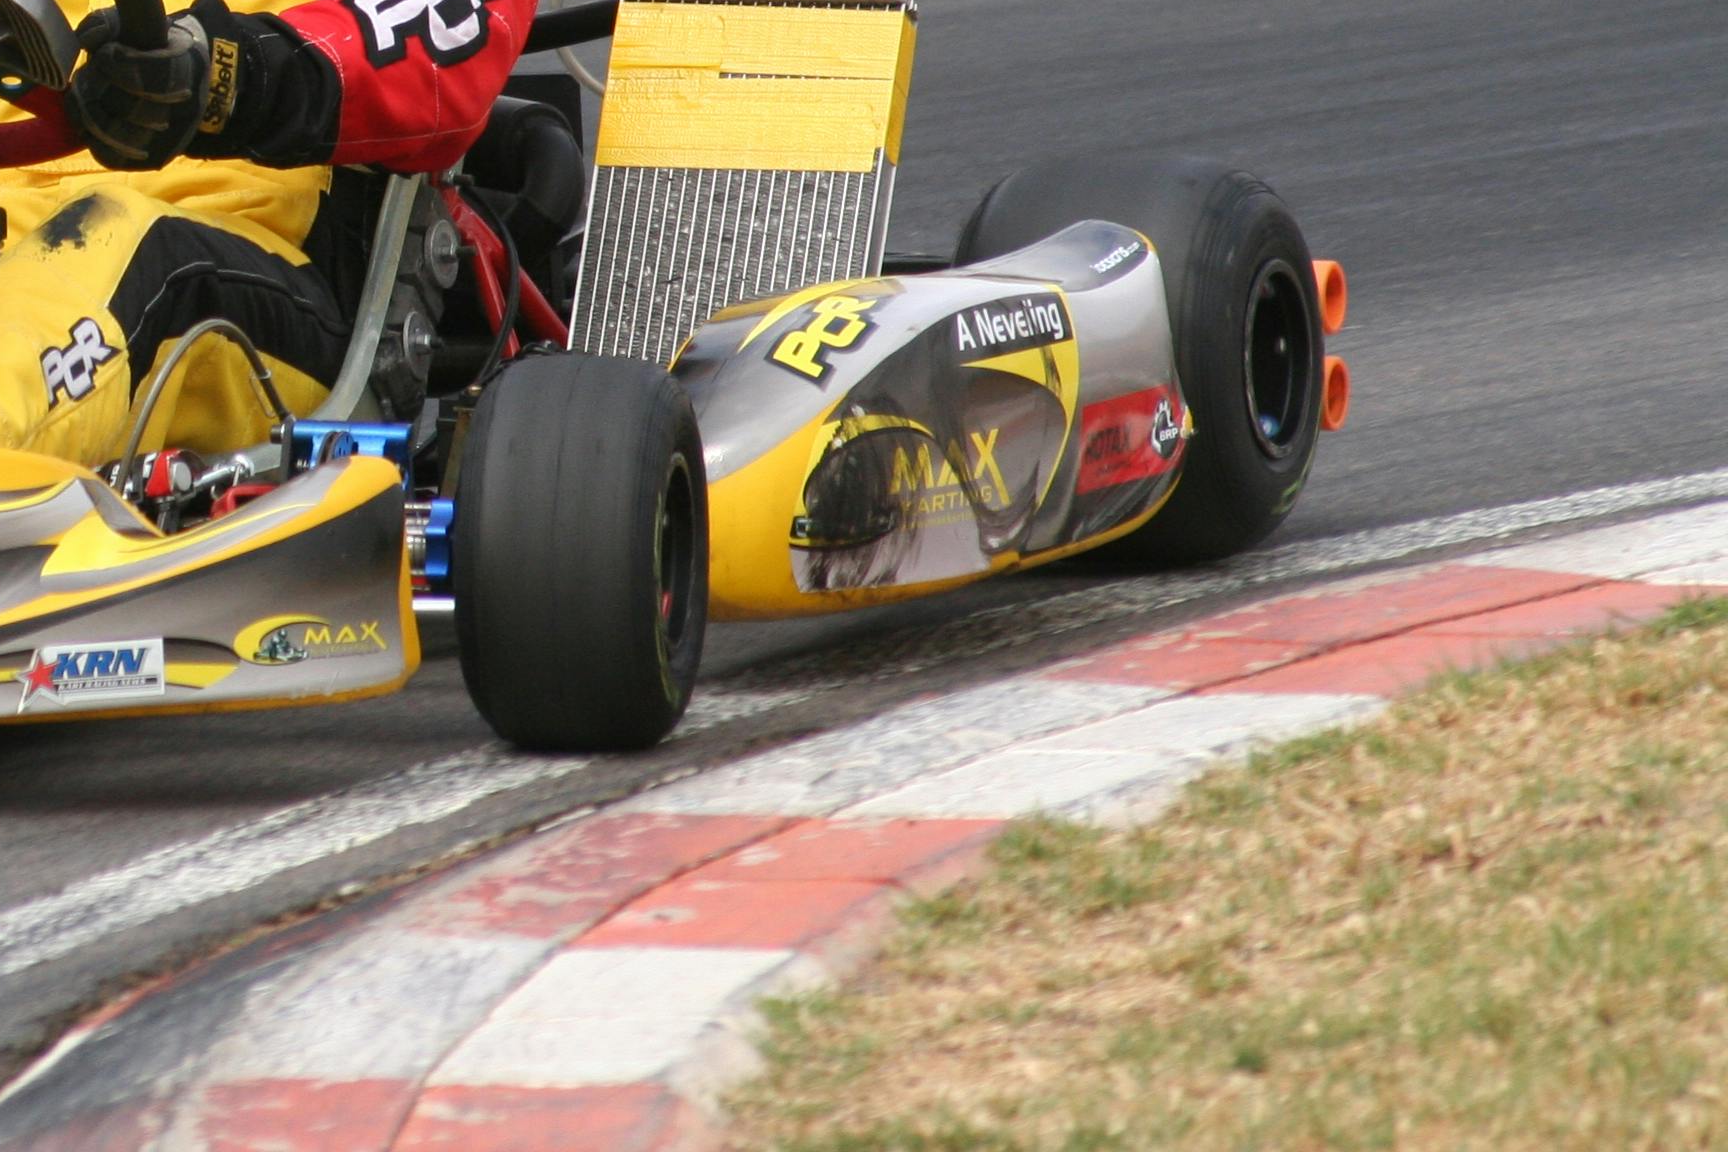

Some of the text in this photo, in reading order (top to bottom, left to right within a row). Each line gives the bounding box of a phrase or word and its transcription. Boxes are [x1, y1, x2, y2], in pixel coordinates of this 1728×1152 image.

[773, 295, 878, 378] PCR
[958, 312, 975, 350] A
[43, 319, 114, 404] PCR
[888, 429, 1010, 509] MAX
[53, 648, 145, 678] KRN
[304, 621, 386, 650] MAX
